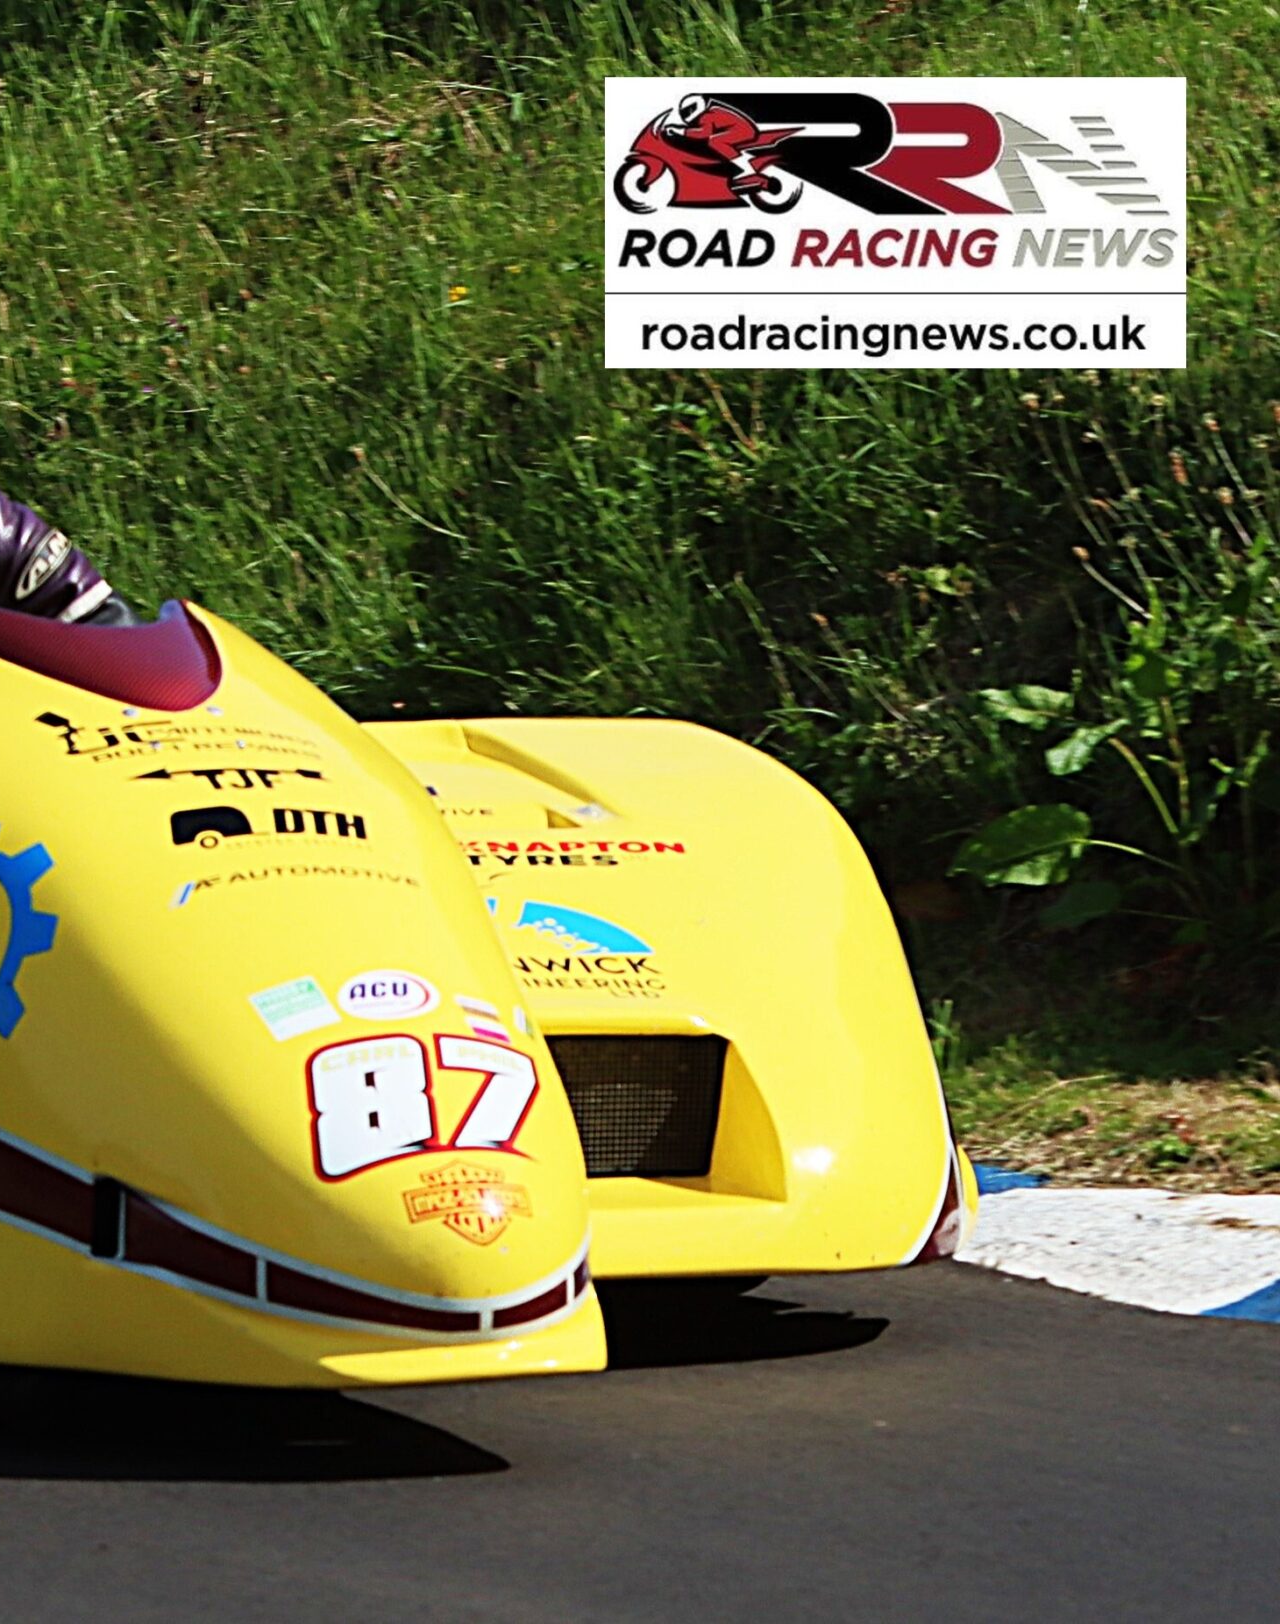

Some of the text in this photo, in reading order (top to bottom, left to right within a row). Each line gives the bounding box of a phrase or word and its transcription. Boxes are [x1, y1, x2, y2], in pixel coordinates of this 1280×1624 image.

[191, 768, 282, 790] TJF
[272, 808, 367, 840] DTH
[458, 840, 686, 853] KNAPTON
[468, 854, 619, 866] TYRES
[228, 863, 421, 888] AUTOMOTIVE
[349, 981, 408, 1000] ACU
[306, 1033, 540, 1182] 87
